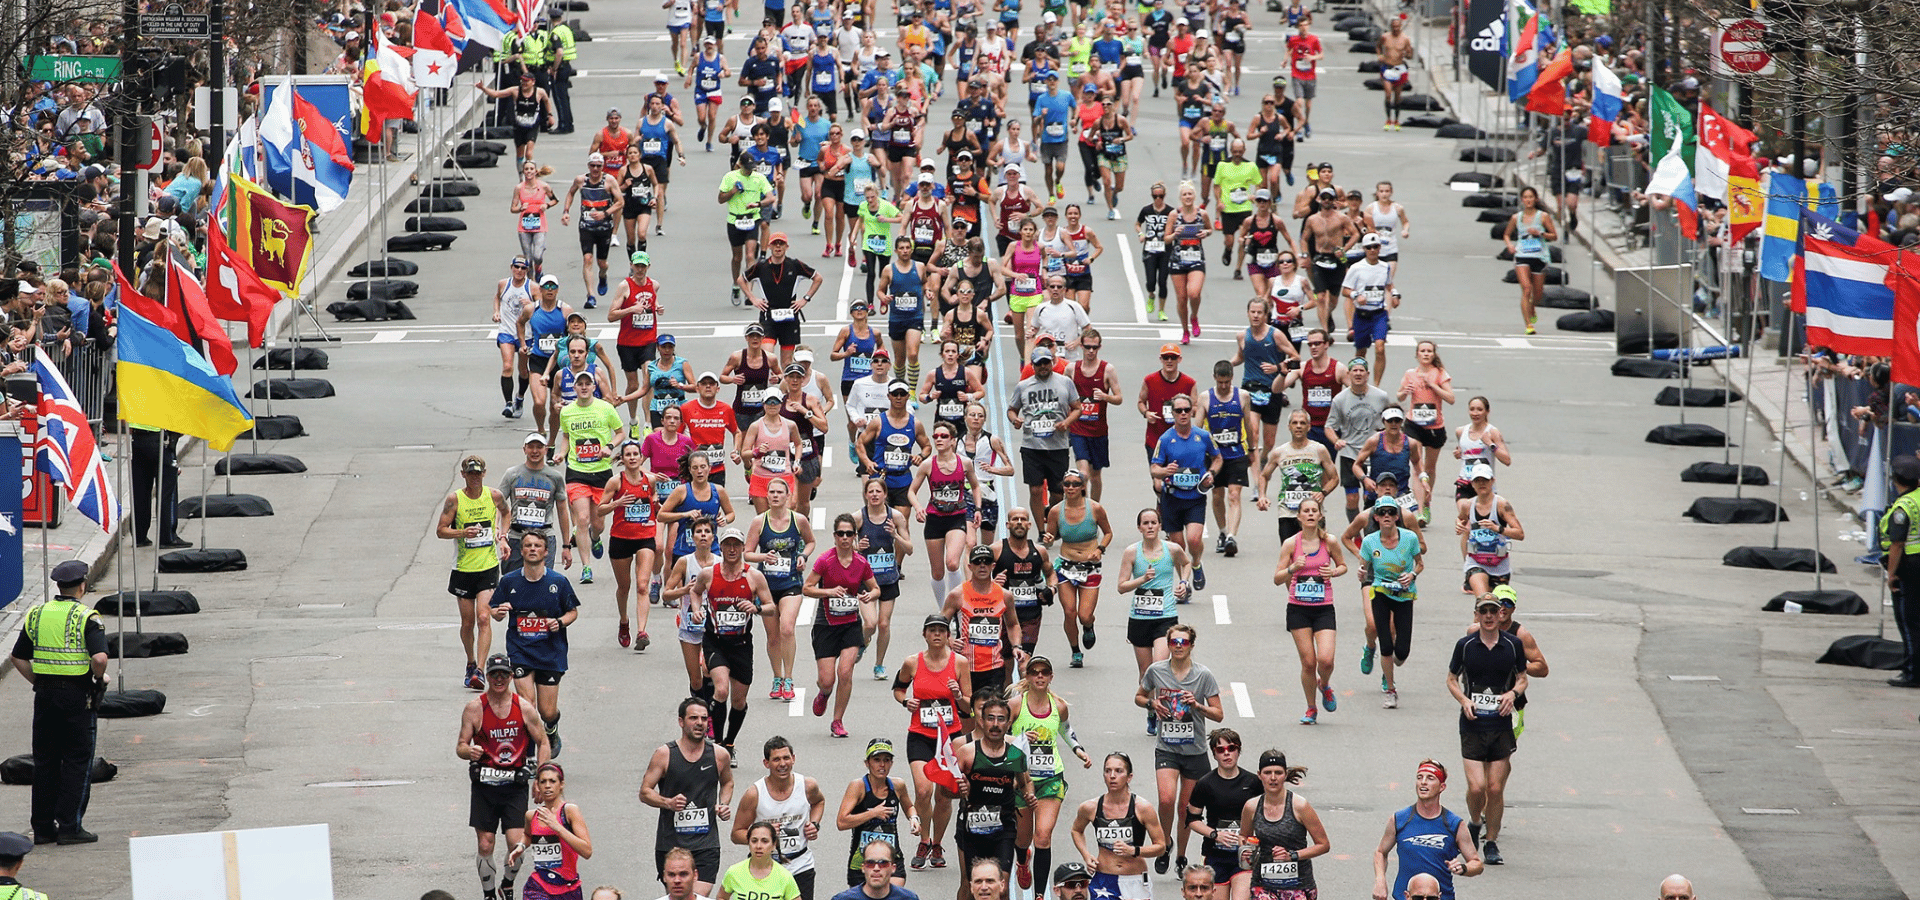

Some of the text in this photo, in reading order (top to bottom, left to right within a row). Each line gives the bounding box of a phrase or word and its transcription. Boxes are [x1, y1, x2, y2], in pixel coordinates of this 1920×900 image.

[1733, 54, 1761, 63] ENTER
[54, 61, 81, 79] RING
[773, 309, 792, 317] 9534
[742, 390, 763, 399] 1515
[571, 420, 603, 431] CHICAGO
[577, 445, 600, 455] 2530
[763, 456, 786, 466] 14677
[1175, 474, 1200, 484] 16318
[519, 508, 545, 518] 12220
[627, 504, 650, 514] 16380
[868, 555, 895, 564] 17169
[1297, 583, 1324, 593] 17001
[830, 598, 858, 608] 13652
[1135, 596, 1163, 606] 15375
[717, 612, 746, 622] 11739
[519, 618, 546, 628] 4575
[970, 625, 999, 634] 10855
[489, 727, 519, 738] MILPAT
[1163, 723, 1193, 733] 13595
[678, 809, 705, 821] 8679
[970, 812, 999, 823] 13017
[1098, 827, 1132, 839] 12510
[1263, 863, 1297, 874] 14268
